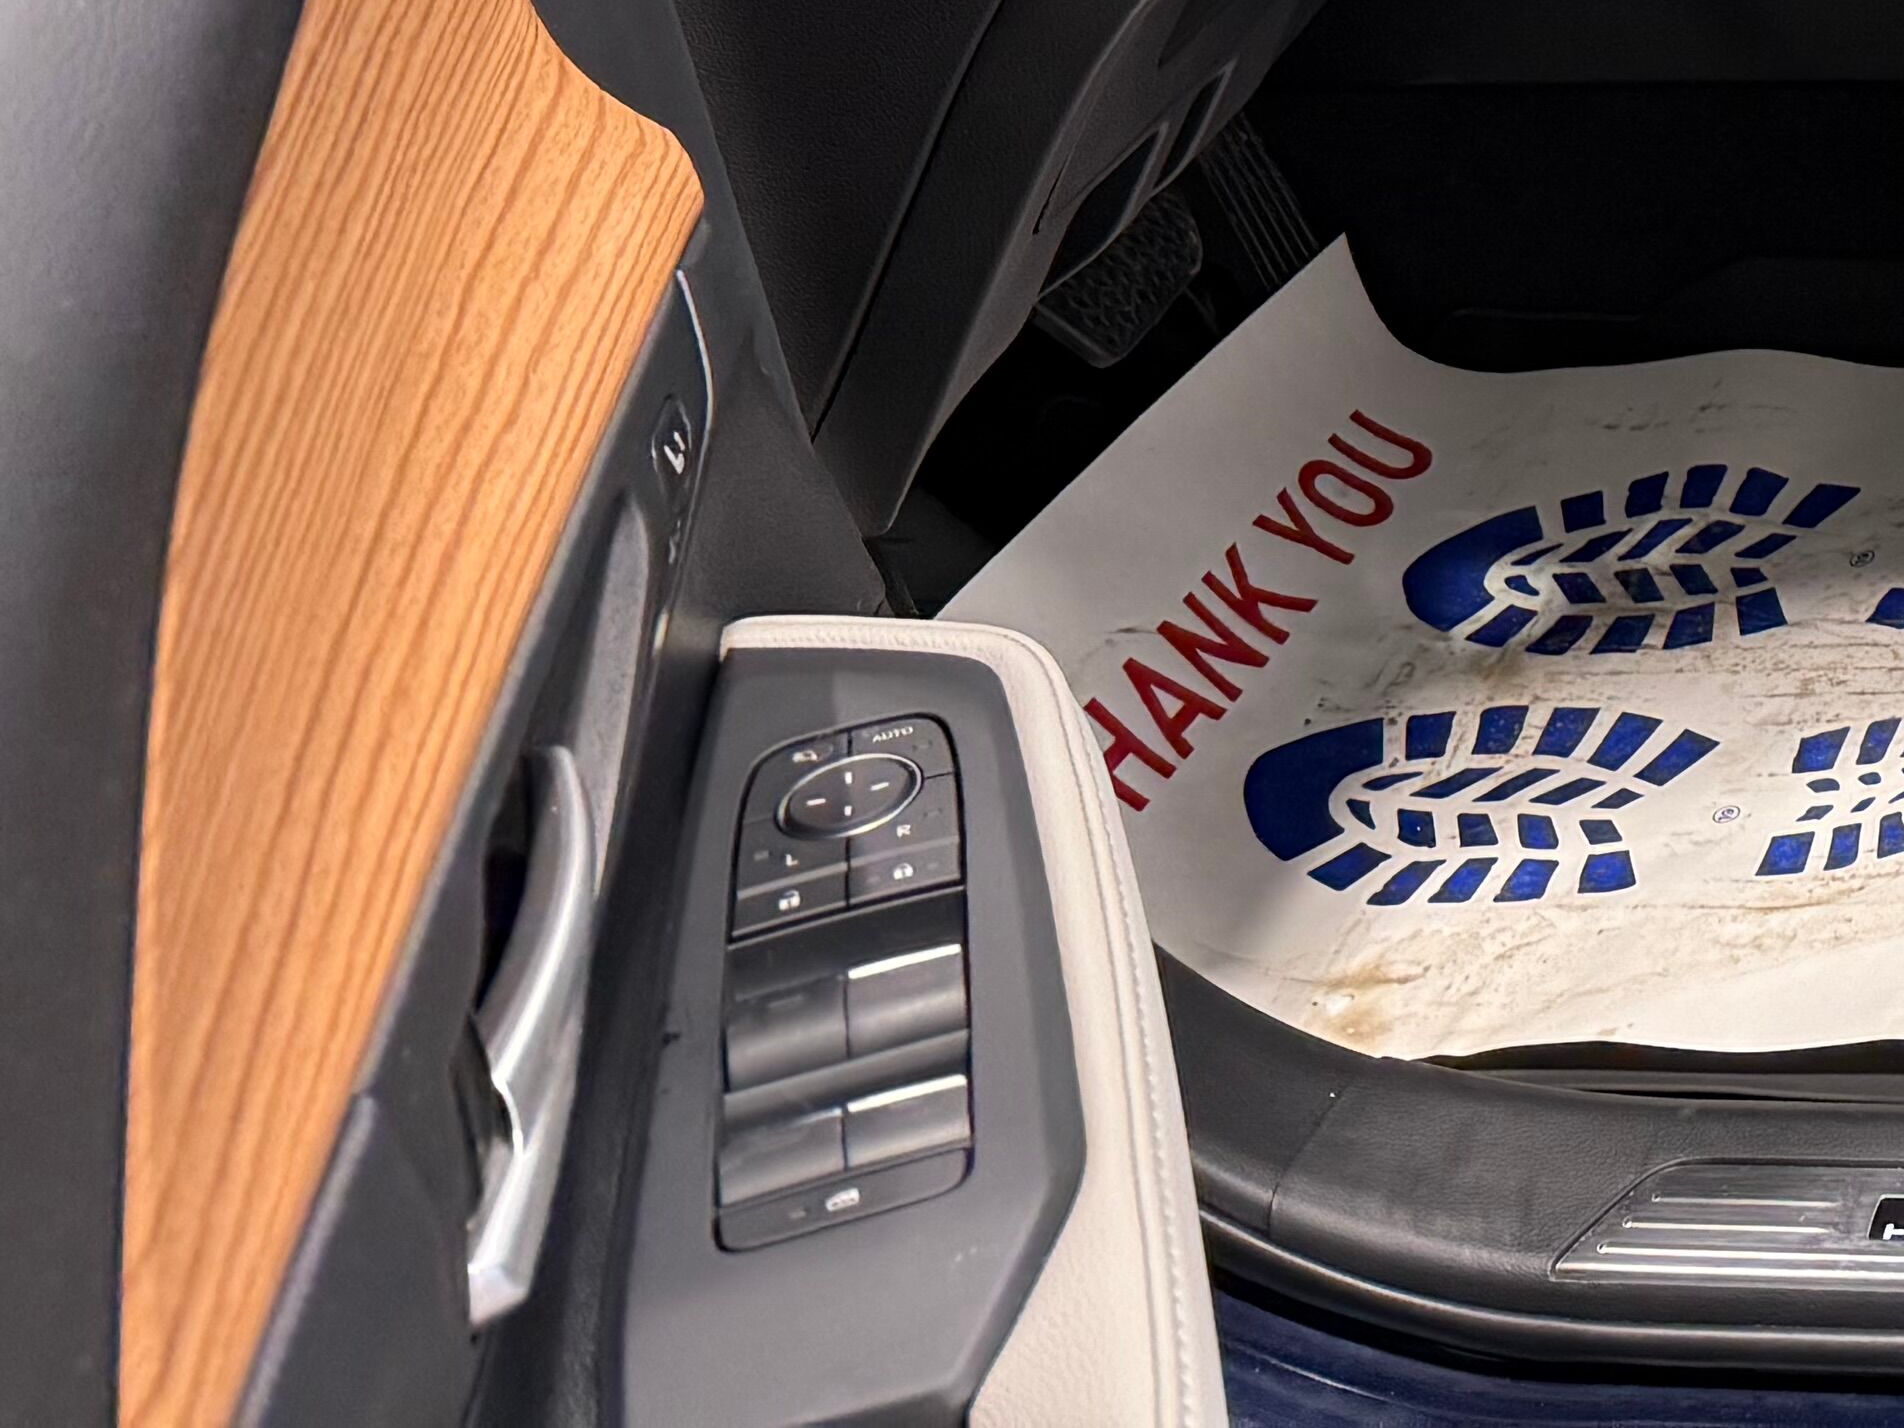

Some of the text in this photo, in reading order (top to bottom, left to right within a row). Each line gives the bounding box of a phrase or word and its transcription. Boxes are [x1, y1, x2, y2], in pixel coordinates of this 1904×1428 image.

[1084, 409, 1433, 812] HANK YOU
[872, 726, 914, 743] AUTO
[896, 824, 911, 838] R
[785, 853, 799, 867] L
